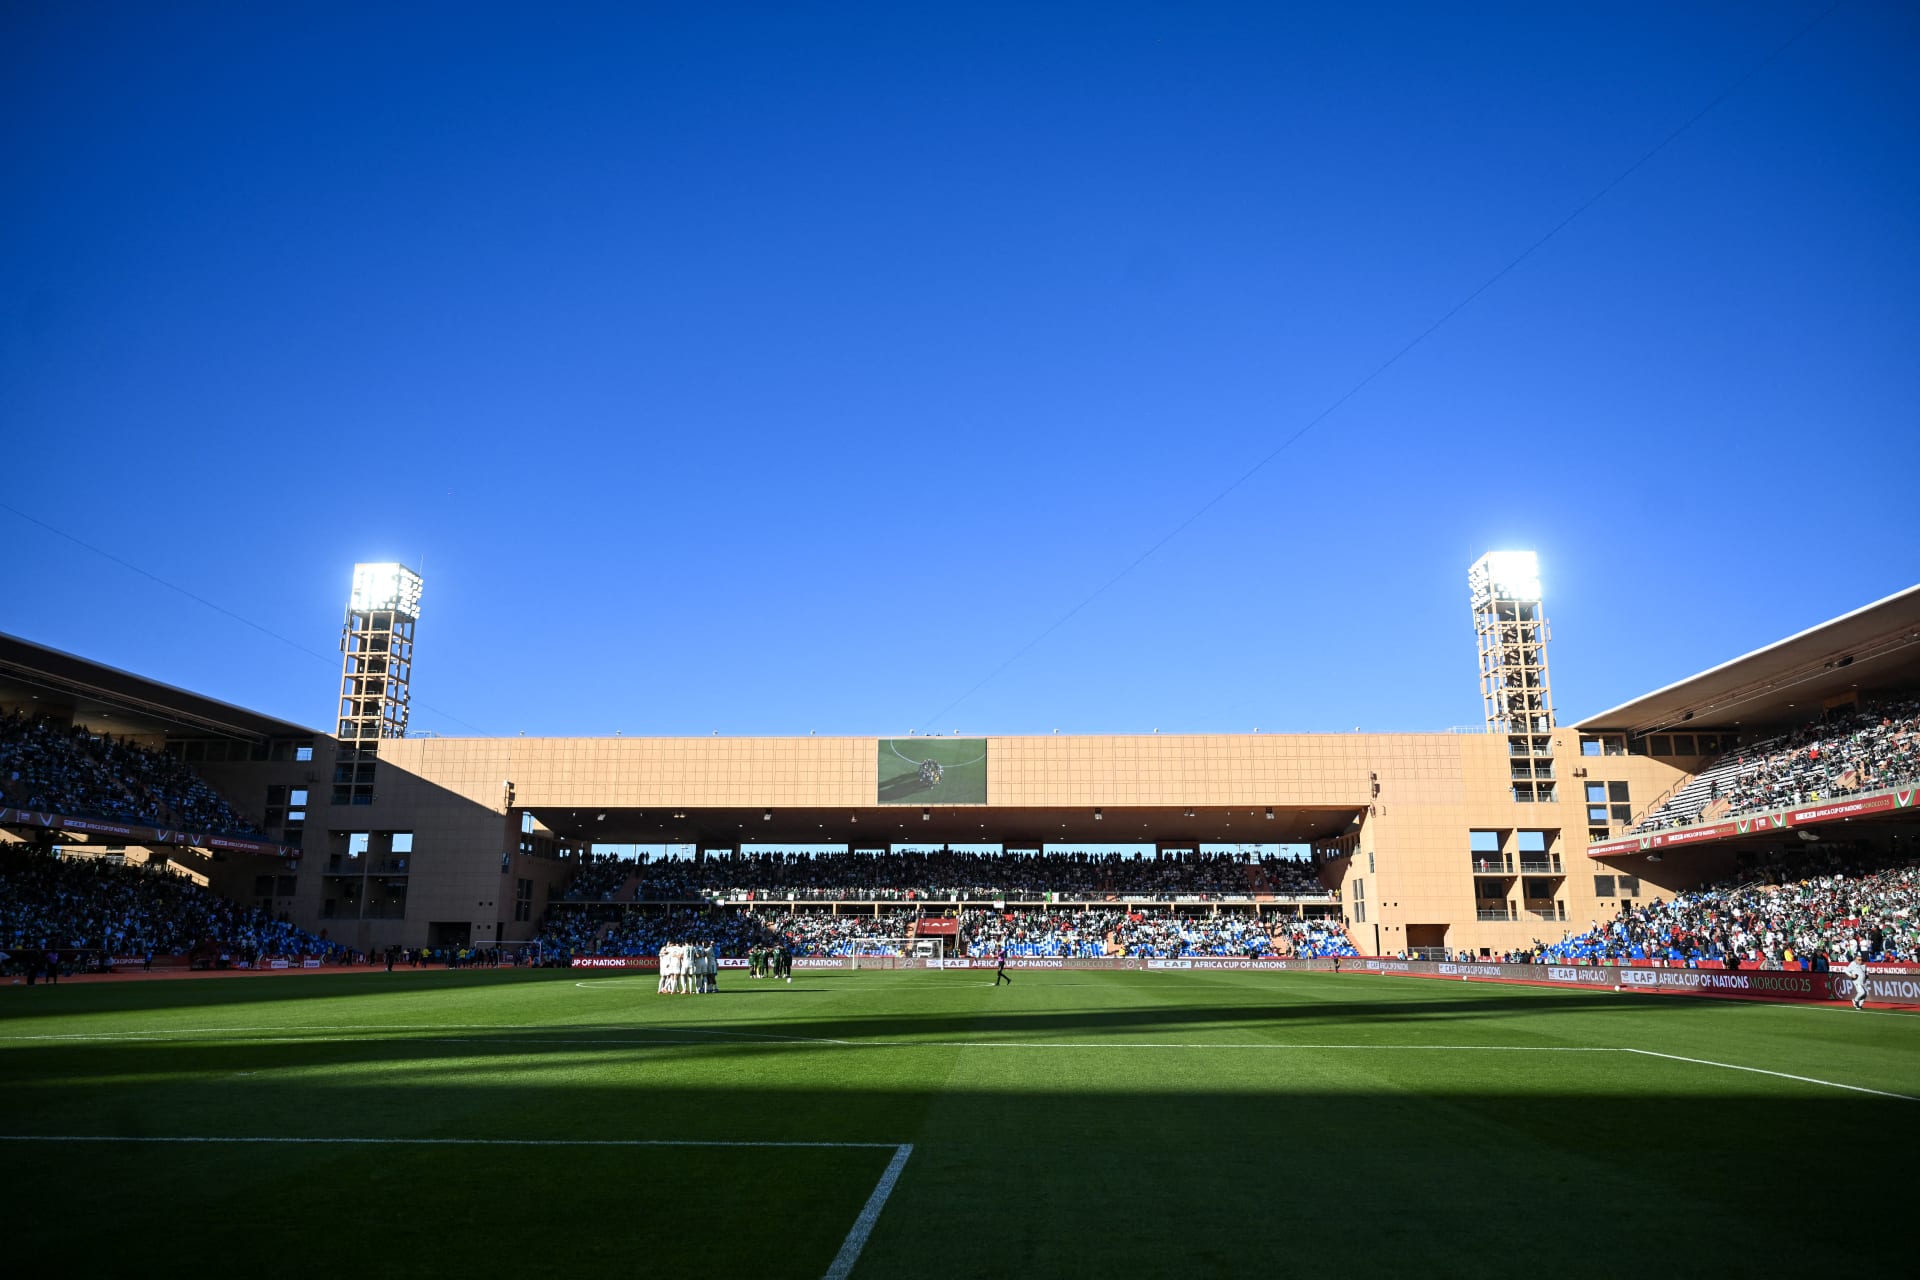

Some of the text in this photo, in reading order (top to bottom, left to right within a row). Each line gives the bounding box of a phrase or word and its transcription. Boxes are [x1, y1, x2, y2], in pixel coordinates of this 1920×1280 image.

[797, 959, 809, 967] OF
[810, 959, 843, 967] NATIONS
[1558, 969, 1574, 979] CAF
[1578, 970, 1599, 981] AFRICA
[1634, 972, 1811, 992] CAF AFRICA CUP OF NATIONS MOROCCO 25
[1841, 979, 1853, 995] UP
[1873, 980, 1920, 998] NATION
